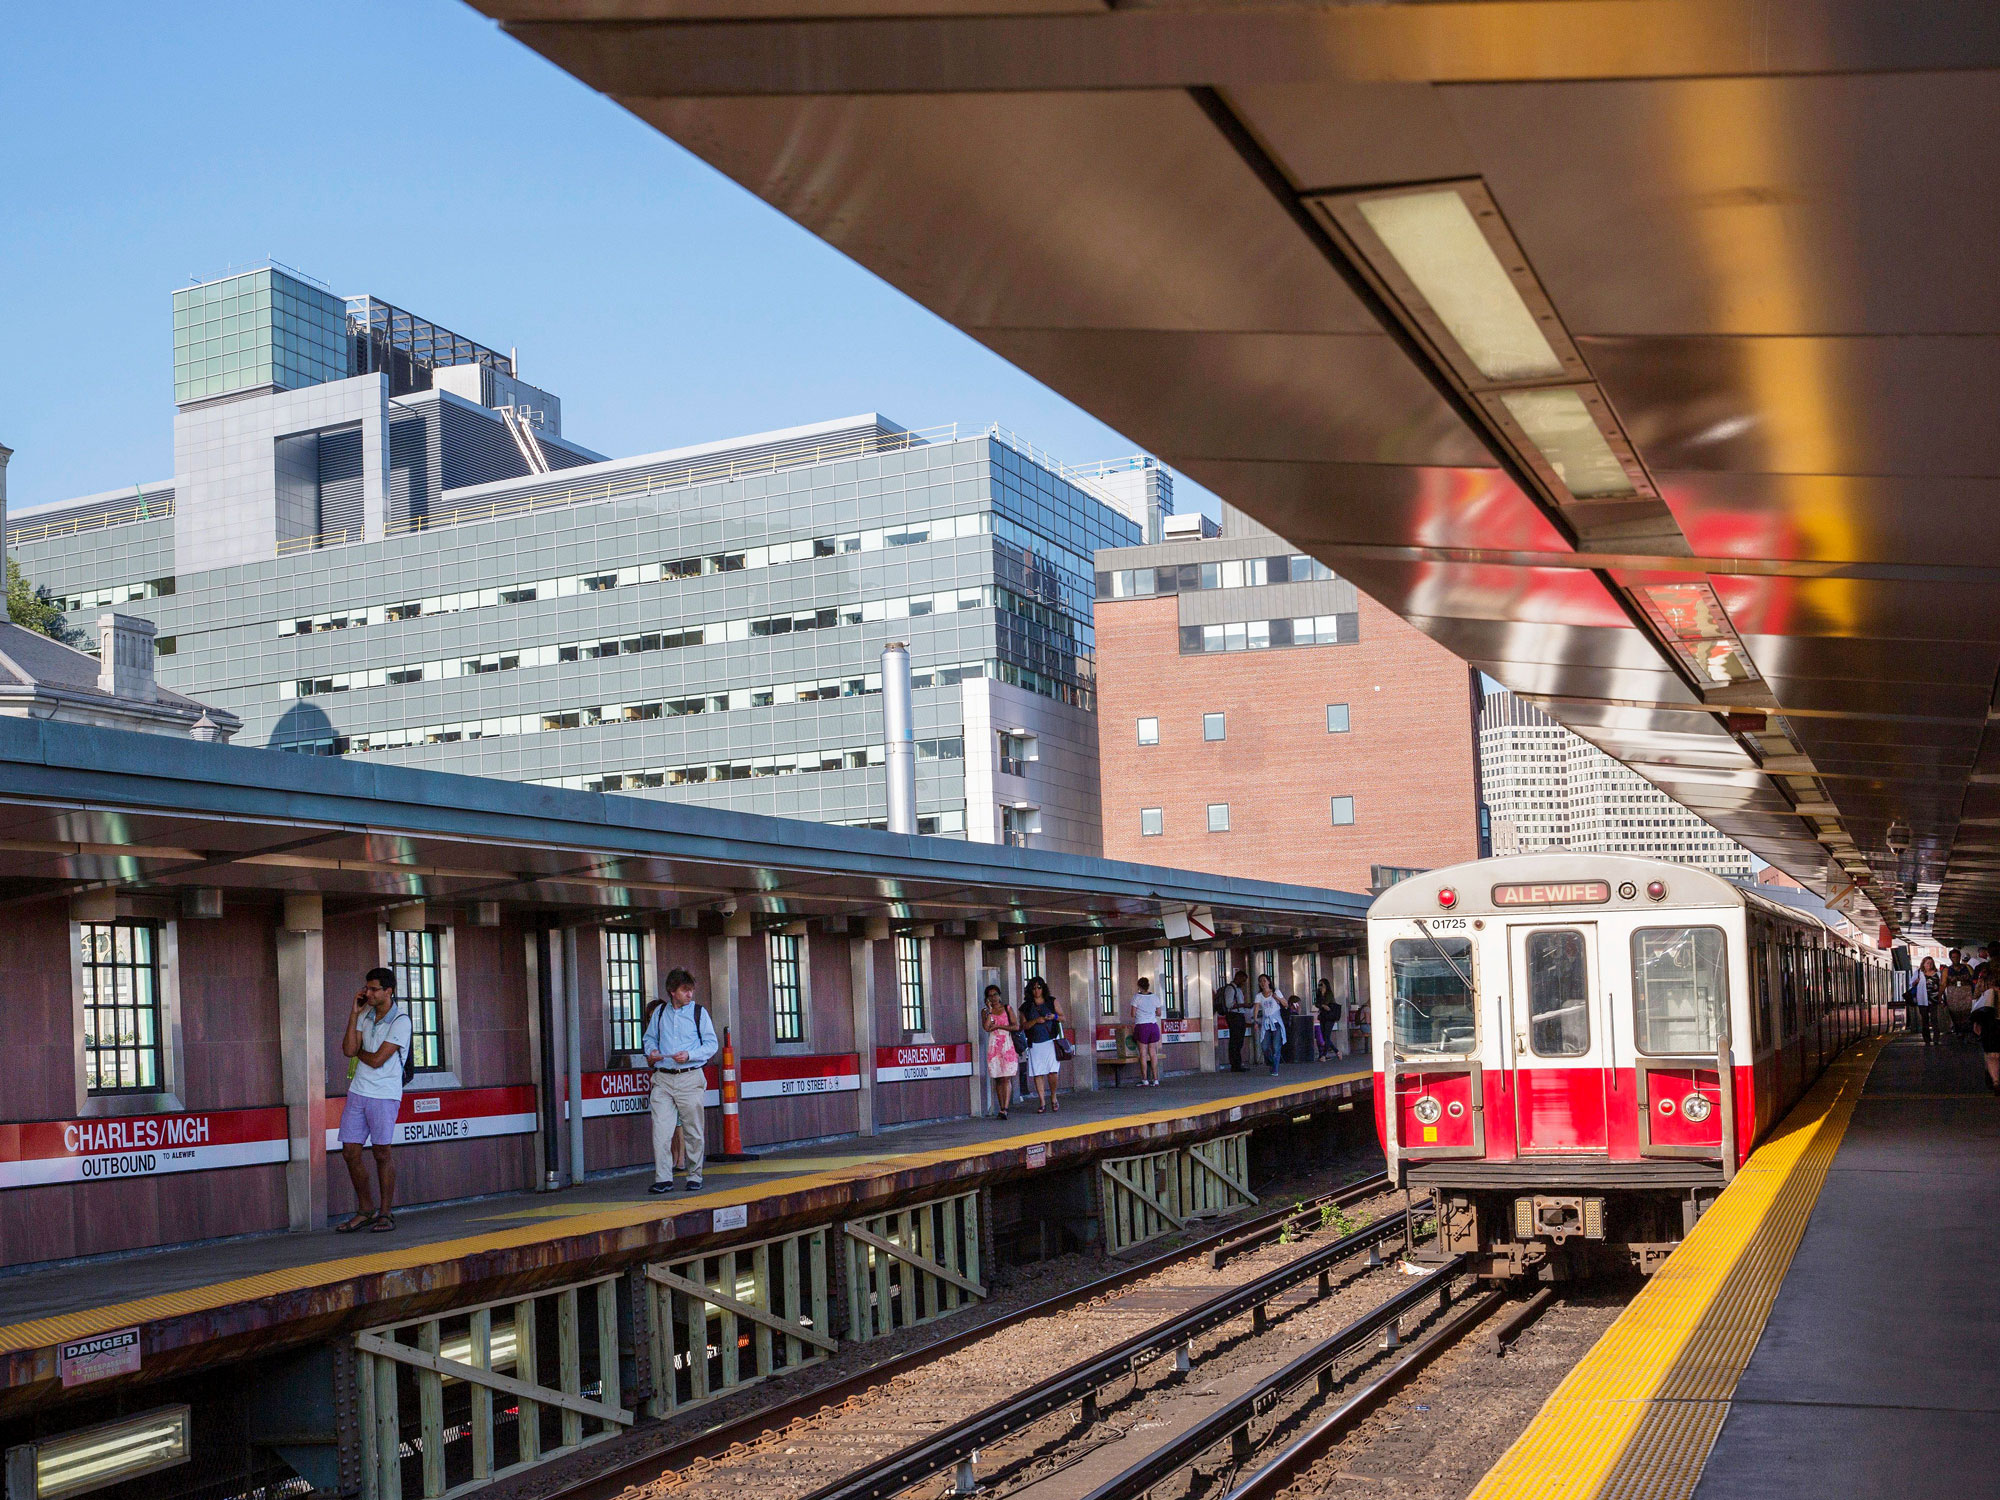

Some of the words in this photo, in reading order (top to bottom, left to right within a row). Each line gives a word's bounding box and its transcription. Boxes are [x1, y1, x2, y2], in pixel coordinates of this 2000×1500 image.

[1504, 884, 1599, 903] ALEWIFE
[1432, 919, 1467, 929] 01725
[898, 1047, 946, 1065] CHARLES/MGH
[904, 1067, 929, 1079] OUTBOUND
[601, 1073, 650, 1095] CHARLES
[782, 1081, 794, 1093] EXIT
[797, 1080, 805, 1092] TO
[806, 1079, 827, 1091] STREET
[610, 1097, 649, 1113] OUTBOUND
[64, 1117, 209, 1152] CHARLES/MGH
[404, 1122, 459, 1141] ESPLANADE
[163, 1152, 171, 1160] TO
[172, 1150, 196, 1159] ALEWIFE
[82, 1154, 156, 1177] OUTBOUND
[66, 1334, 134, 1358] DANGER
[72, 1368, 82, 1377] NO
